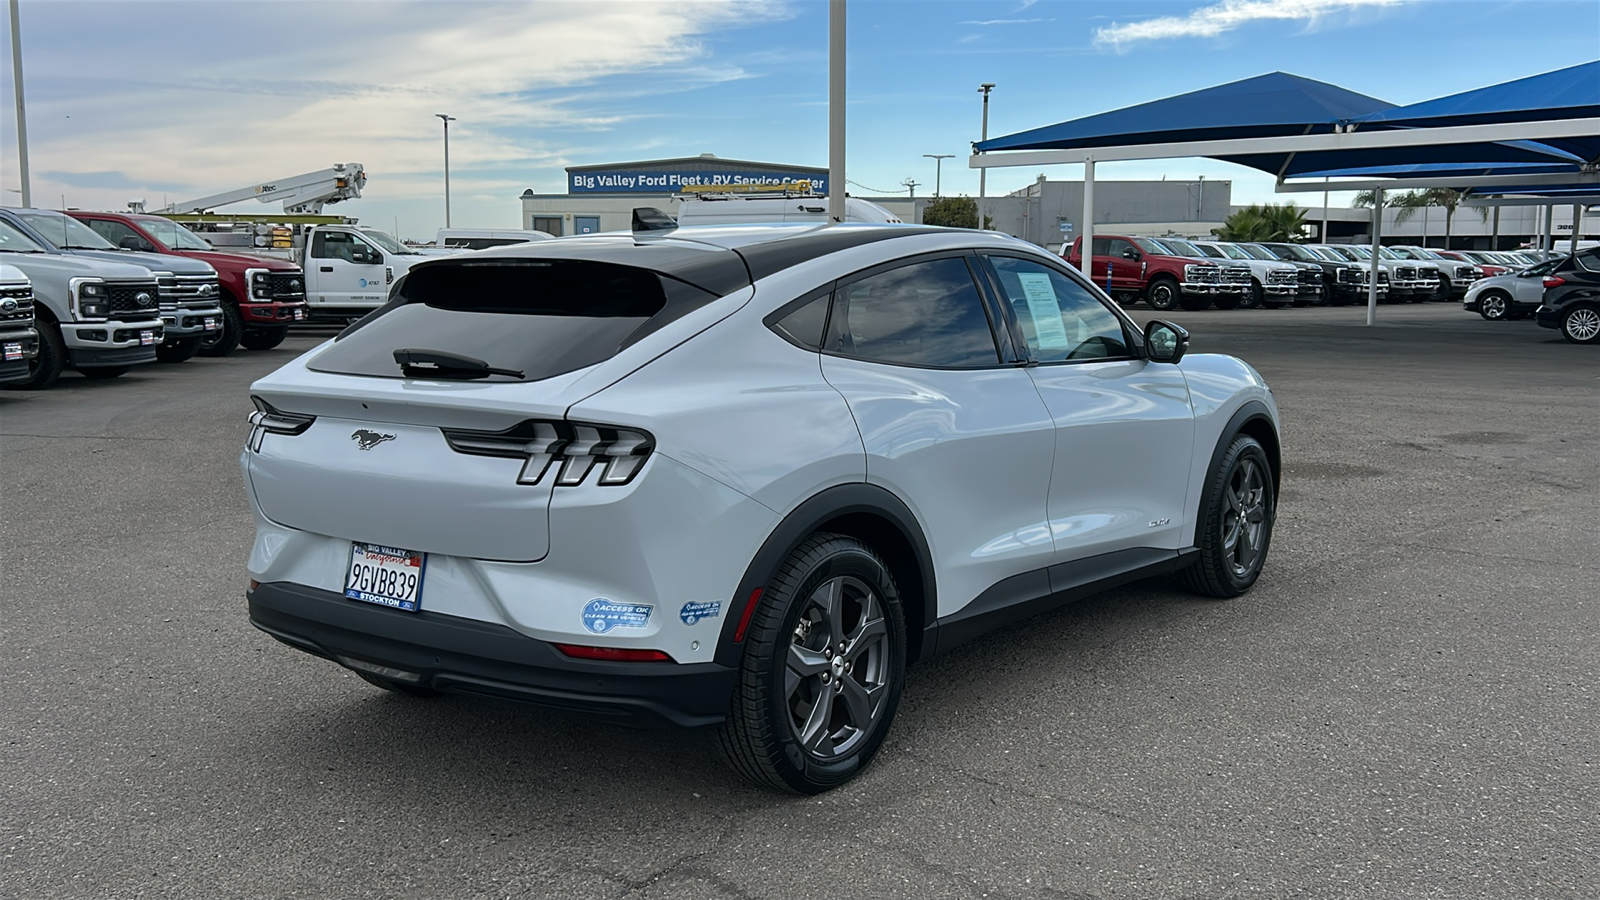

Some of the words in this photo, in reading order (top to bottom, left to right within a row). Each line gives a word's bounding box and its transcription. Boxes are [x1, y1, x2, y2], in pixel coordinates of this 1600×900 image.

[574, 175, 595, 188] Big
[597, 175, 636, 188] Valley
[638, 175, 666, 186] Ford
[669, 175, 701, 186] Fleet
[713, 175, 731, 185] RV
[733, 176, 779, 185] Service
[368, 544, 380, 553] BIG
[381, 546, 407, 557] VALLEY
[365, 552, 406, 566] California
[350, 563, 417, 600] 9GVB839
[360, 593, 400, 607] STOCKTON
